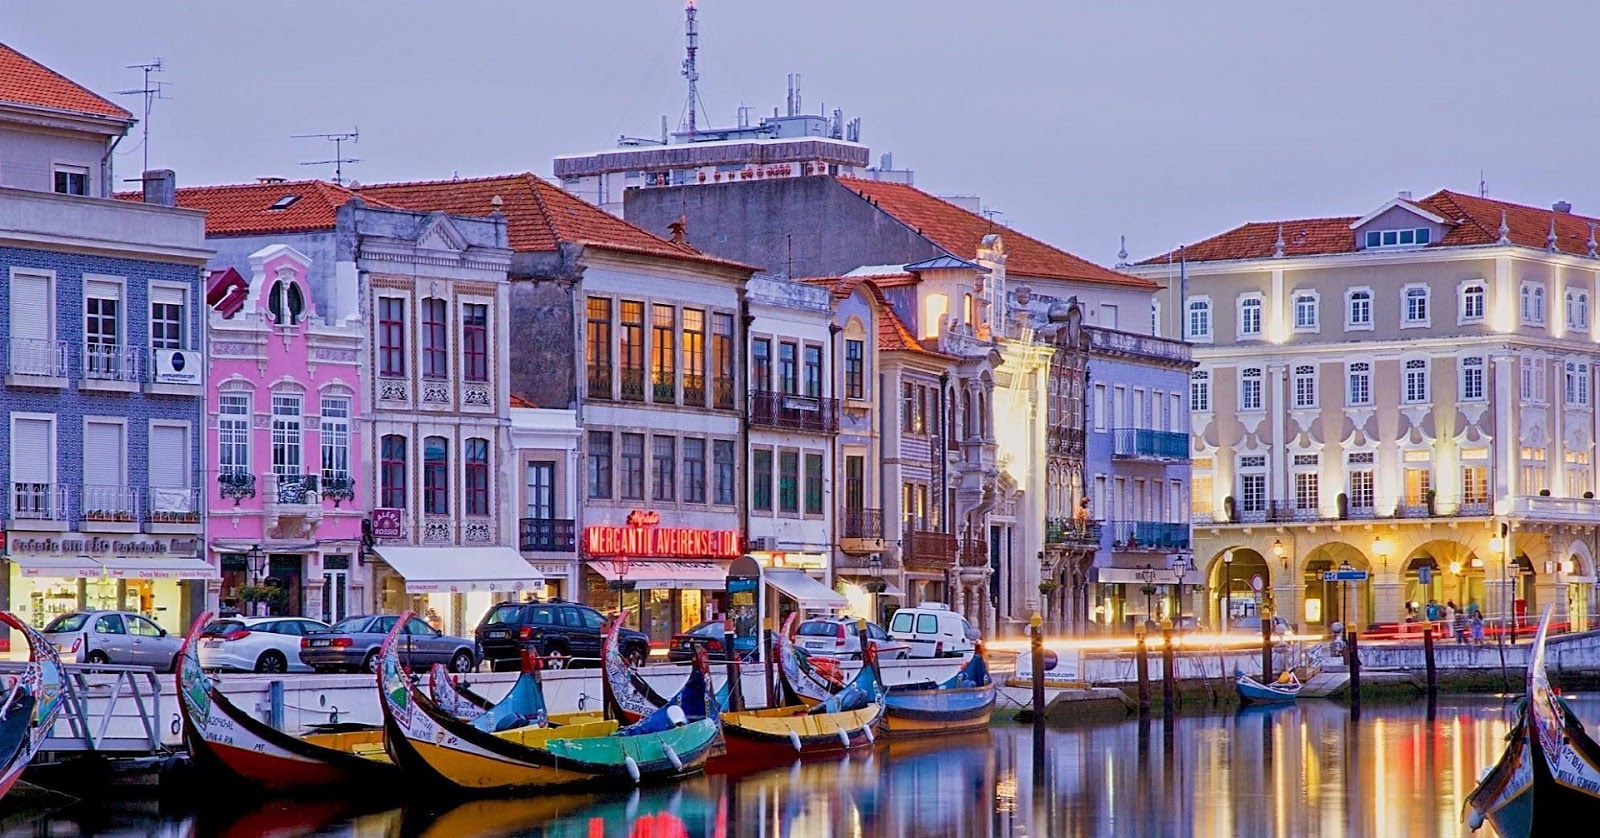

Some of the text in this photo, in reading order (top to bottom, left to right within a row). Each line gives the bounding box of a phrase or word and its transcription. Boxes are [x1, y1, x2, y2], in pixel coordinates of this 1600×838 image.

[373, 511, 400, 528] GALERIA
[375, 528, 398, 536] ROSSIO
[589, 526, 653, 554] MERCANTIL
[718, 530, 741, 557] LDA.
